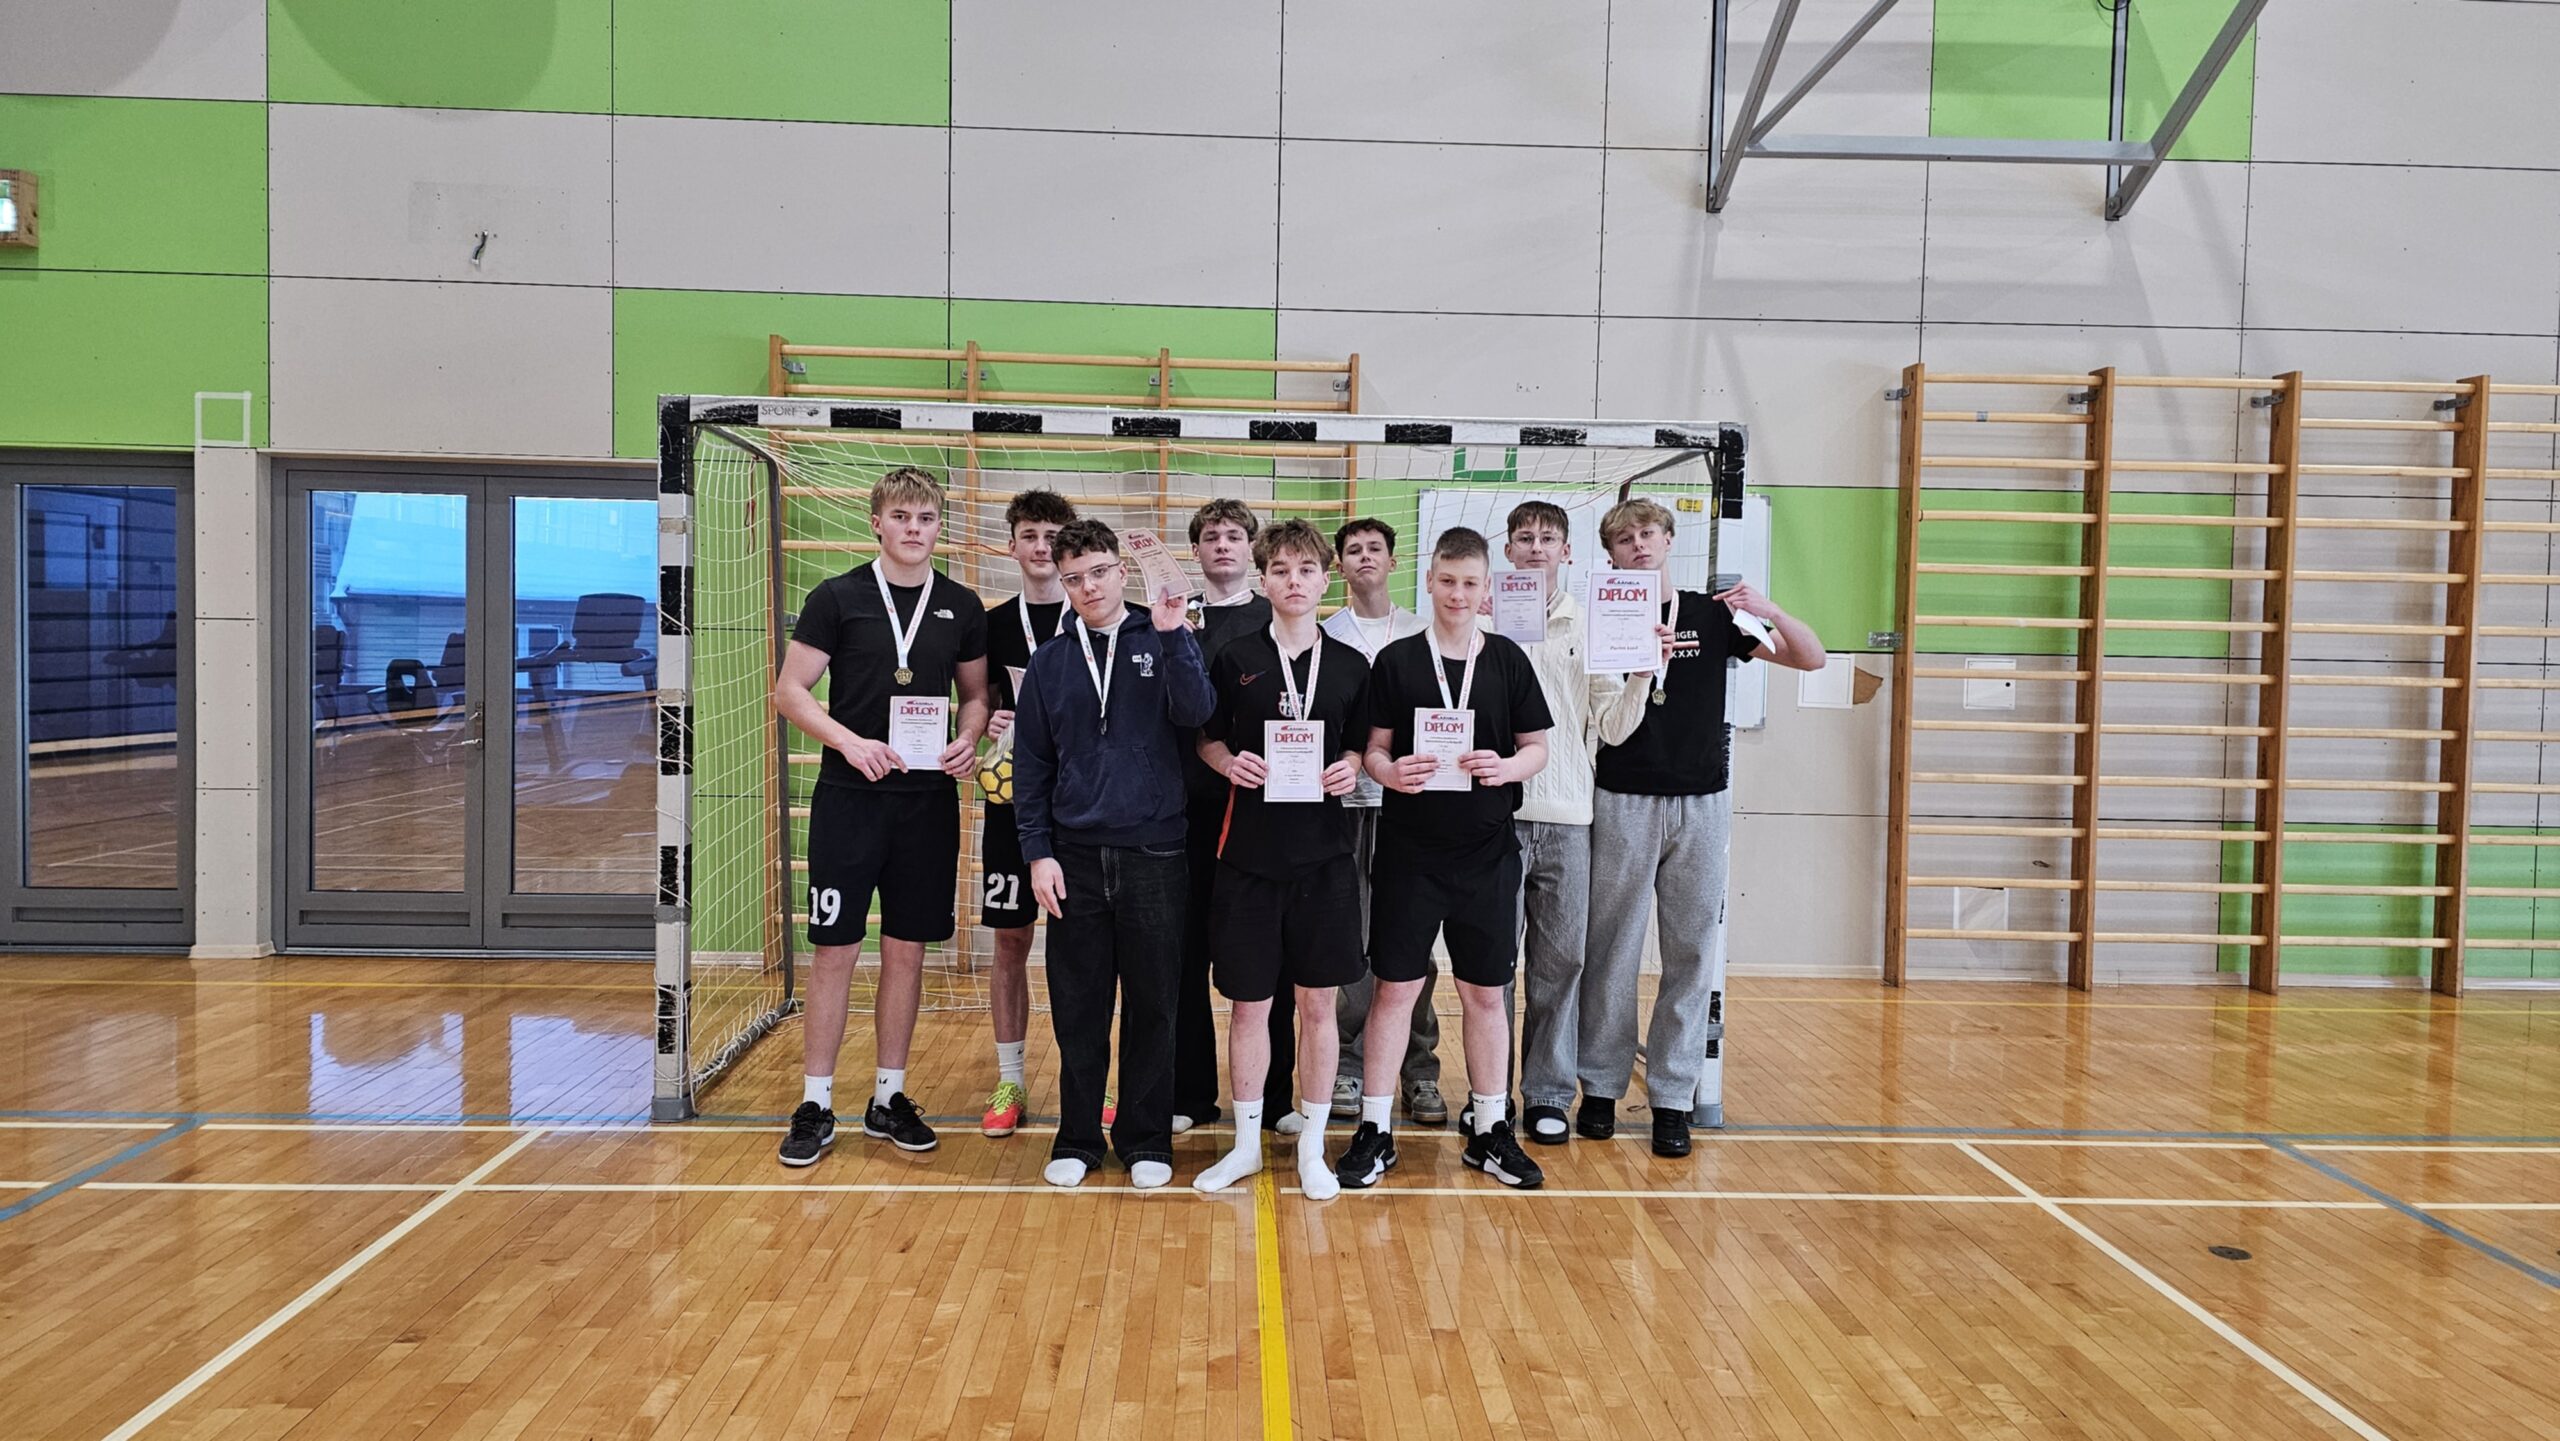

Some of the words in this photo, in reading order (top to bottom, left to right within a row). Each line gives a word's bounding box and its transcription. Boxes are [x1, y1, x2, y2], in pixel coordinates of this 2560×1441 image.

[1501, 581, 1538, 592] DIPLOM
[1598, 588, 1648, 601] DIPLOM
[1675, 630, 1699, 640] IGER
[1672, 649, 1701, 658] XXXV
[900, 706, 939, 716] DIPLOM
[1424, 721, 1464, 733] DIPLOM
[1274, 733, 1314, 743] DIPLOM
[985, 872, 1020, 910] 21
[810, 886, 841, 926] 19
